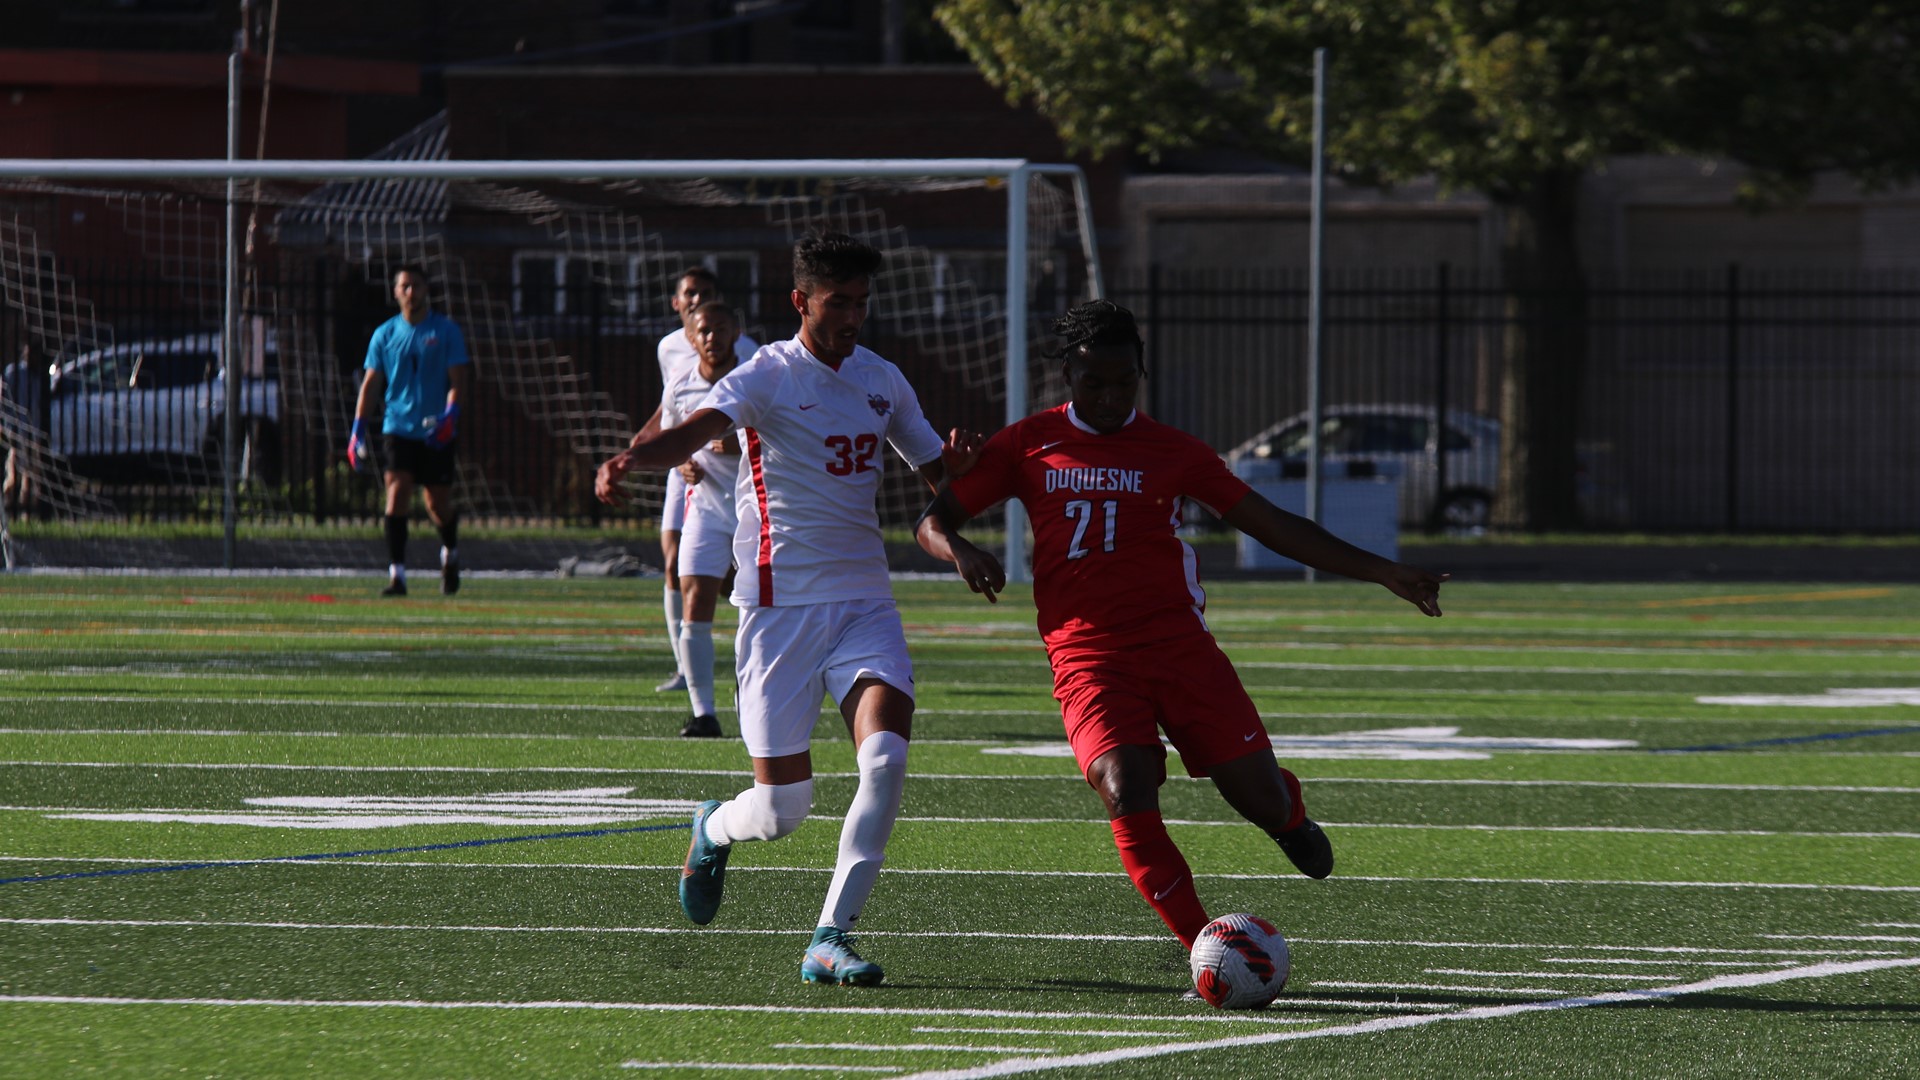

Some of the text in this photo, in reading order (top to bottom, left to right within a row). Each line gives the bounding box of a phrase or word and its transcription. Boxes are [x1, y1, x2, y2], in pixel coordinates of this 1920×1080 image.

[825, 433, 878, 476] 32
[1045, 467, 1143, 493] DUQUESNE
[1065, 499, 1118, 560] 21
